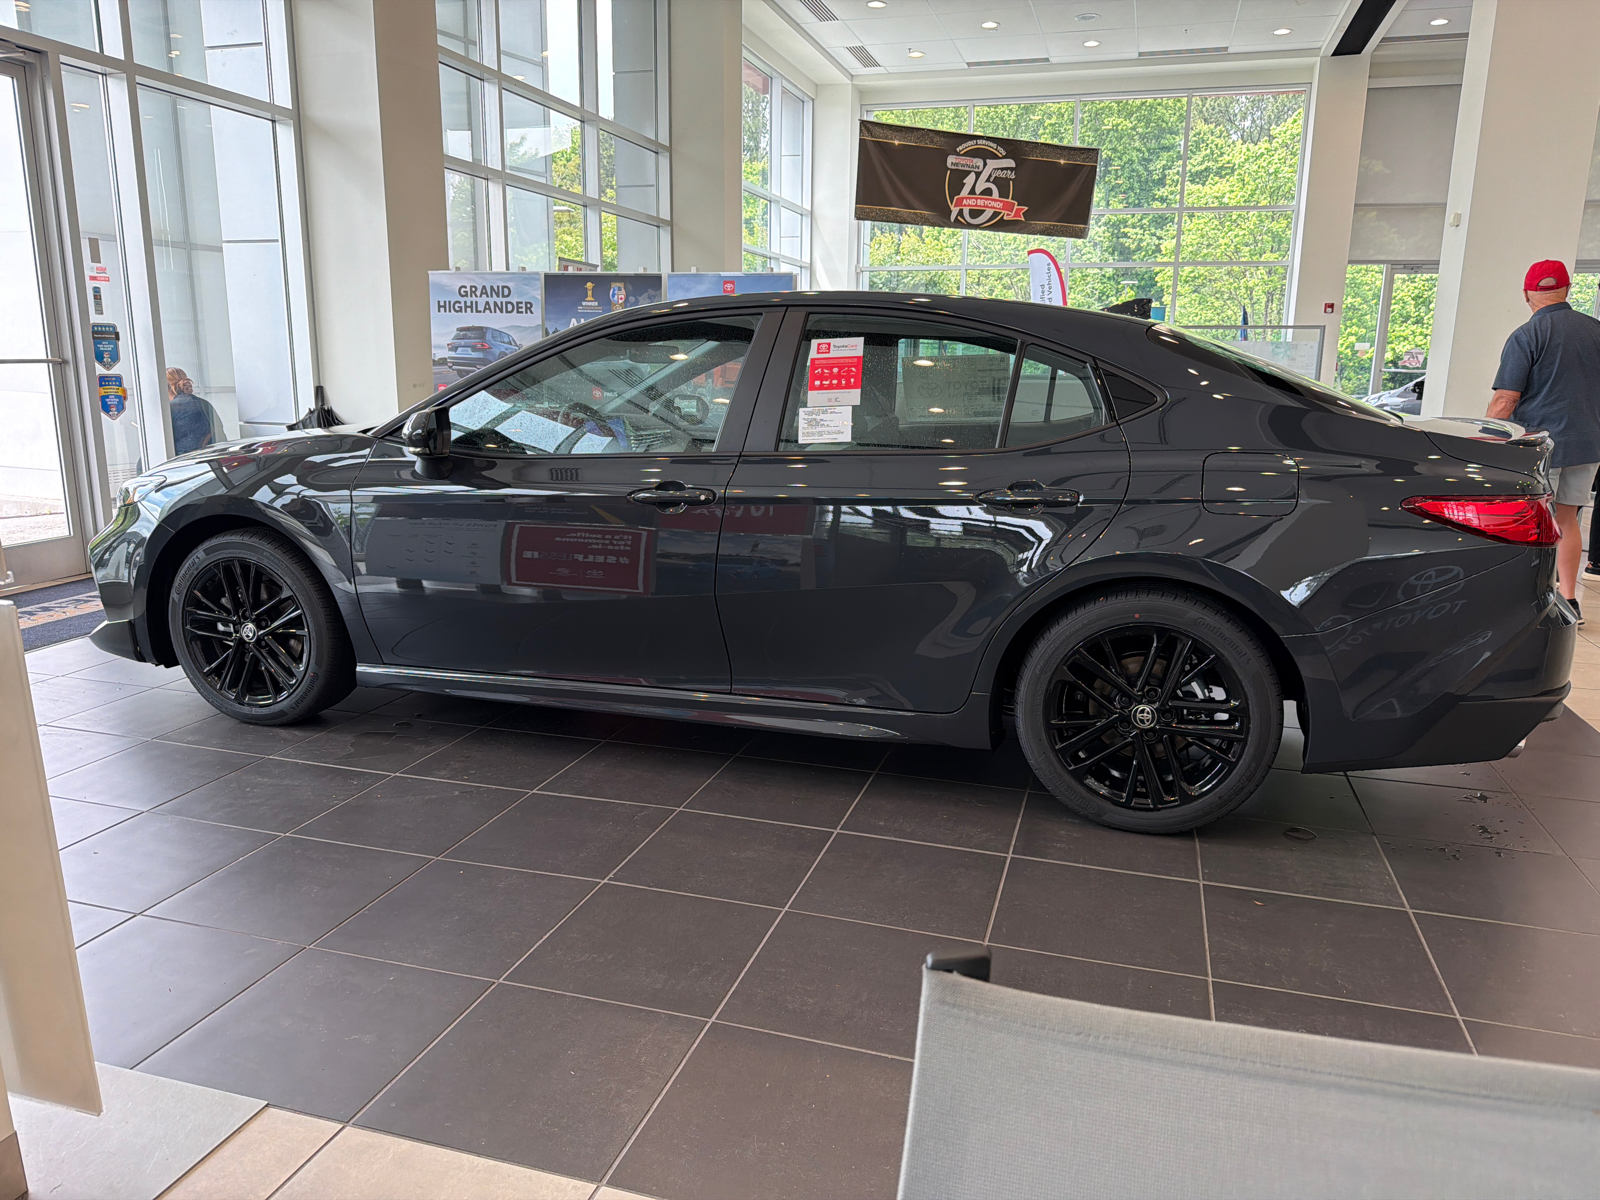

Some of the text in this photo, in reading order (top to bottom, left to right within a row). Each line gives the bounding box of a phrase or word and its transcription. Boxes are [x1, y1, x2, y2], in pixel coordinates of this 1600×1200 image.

[956, 139, 1007, 156] PROUDLY SERVING YOU
[950, 161, 980, 170] NEWNAN
[950, 158, 1016, 225] 15 years
[962, 198, 1004, 209] AND BEYOND!
[457, 285, 512, 299] GRAND
[436, 300, 534, 316] HIGHLANDER
[174, 558, 198, 595] Continental
[1195, 616, 1248, 660] Continental
[297, 672, 320, 708] Continental
